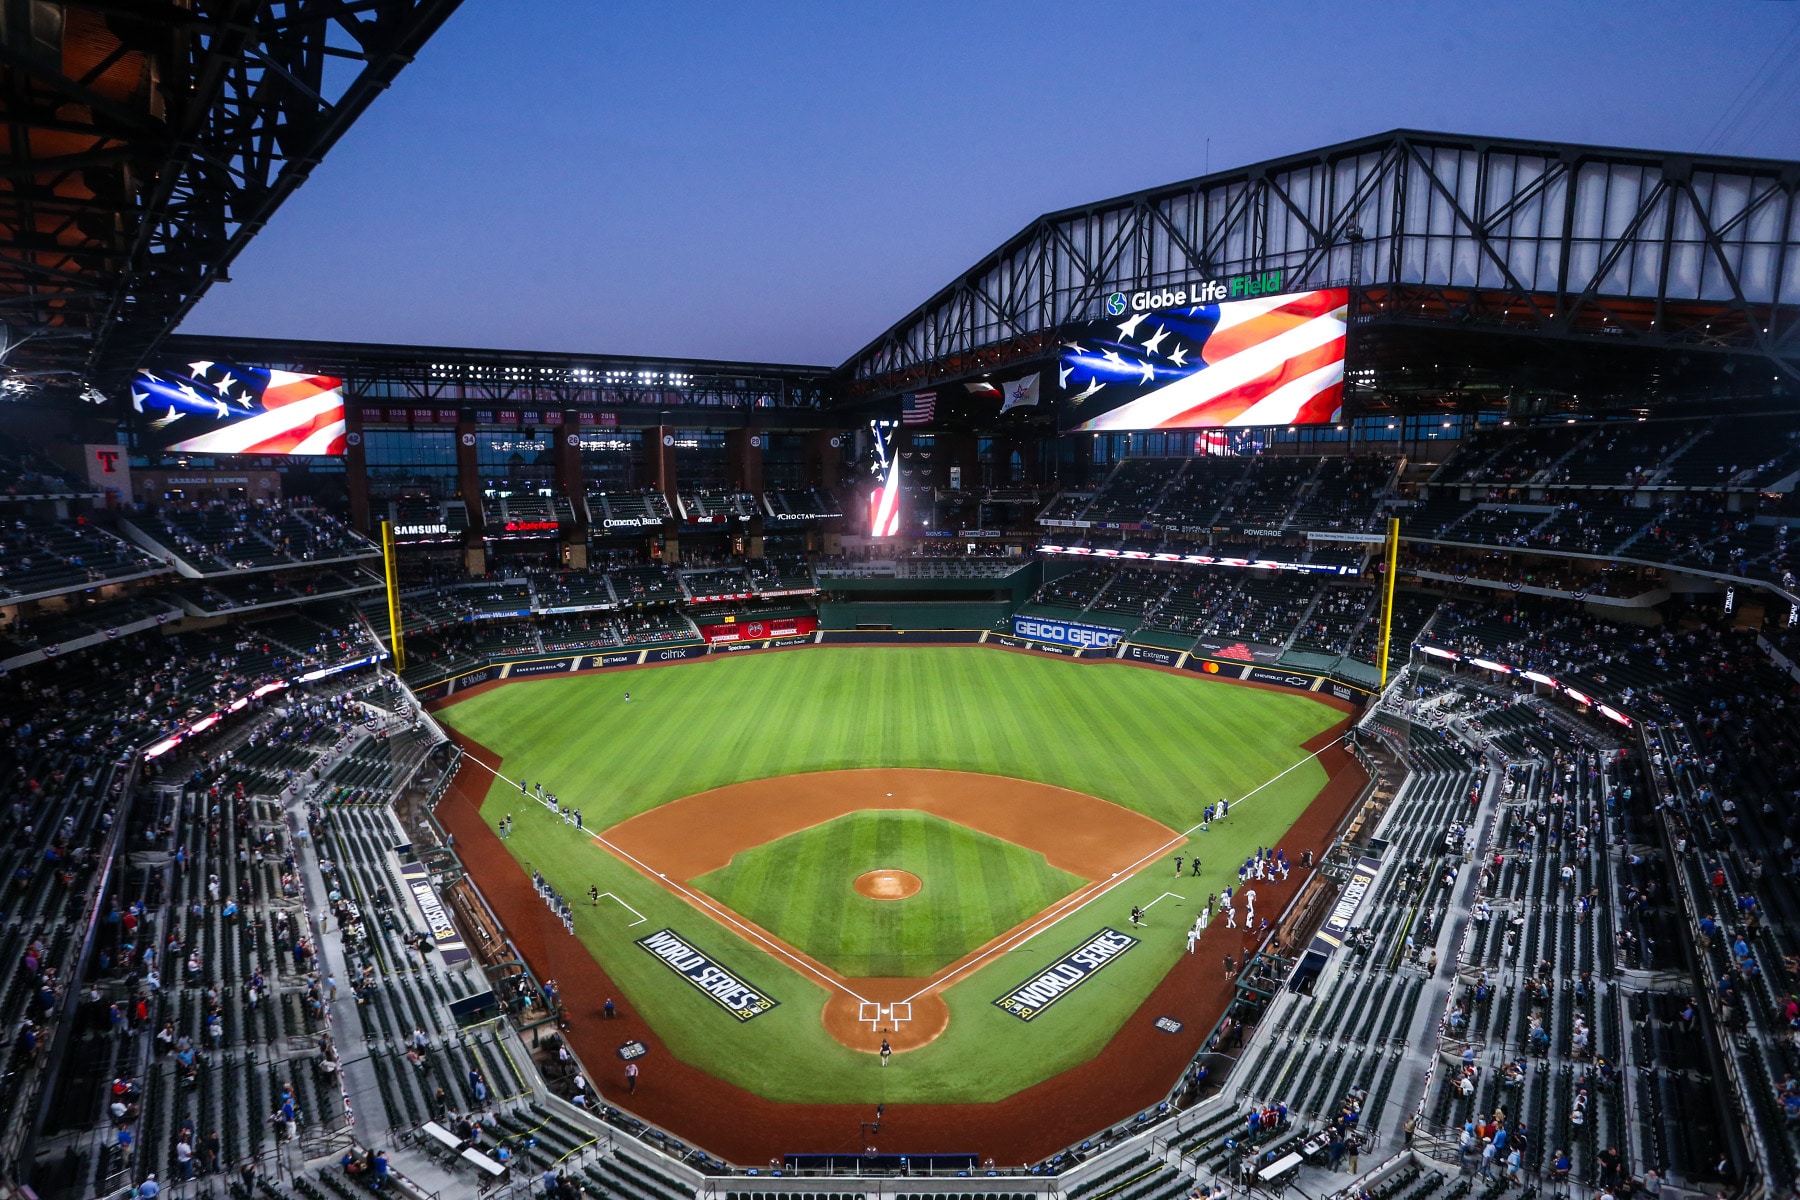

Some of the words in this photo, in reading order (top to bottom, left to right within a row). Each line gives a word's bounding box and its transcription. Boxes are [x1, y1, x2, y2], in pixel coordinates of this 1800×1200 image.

[1131, 288, 1187, 311] Globe
[1190, 280, 1227, 303] Life
[1231, 271, 1281, 297] Field
[348, 435, 359, 443] 42
[464, 436, 474, 444] 34
[95, 449, 119, 474] T
[641, 517, 663, 525] Bank
[394, 525, 447, 535] SAMSUNG
[1243, 529, 1282, 537] POWERADE
[1015, 621, 1065, 640] GEICO
[660, 648, 686, 660] citrix
[1143, 651, 1170, 660] Extreme
[643, 931, 706, 972] WORLD
[690, 966, 760, 1010] SERIES
[1011, 963, 1085, 1008] WORLD
[1071, 930, 1132, 970] SERIES
[756, 999, 771, 1010] 20
[1000, 999, 1016, 1009] 20
[737, 1008, 754, 1018] 20
[1016, 1007, 1033, 1018] 20
